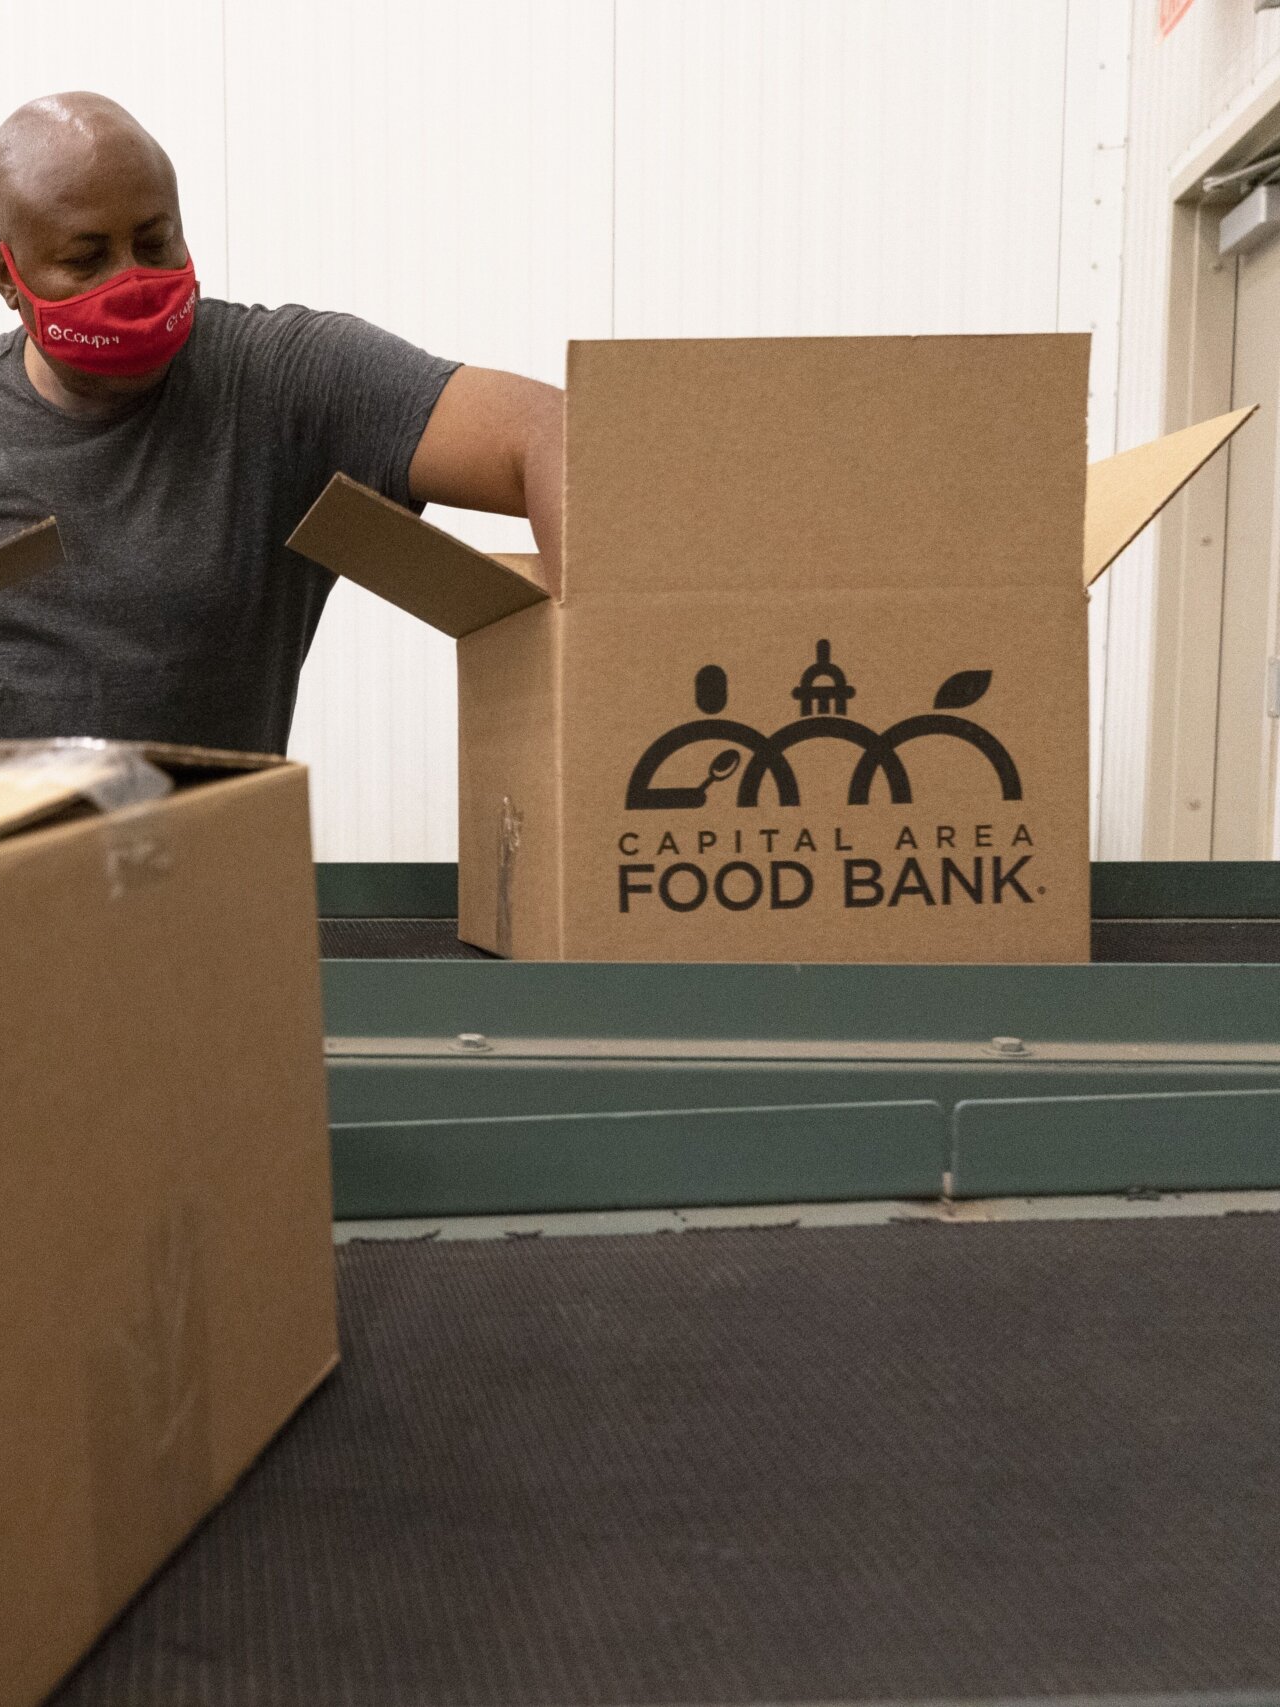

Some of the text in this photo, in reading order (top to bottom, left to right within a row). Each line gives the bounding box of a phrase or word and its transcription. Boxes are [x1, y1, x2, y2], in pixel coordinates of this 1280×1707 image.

[618, 823, 1035, 856] CAPITAL AREA
[618, 859, 815, 914] FOOD
